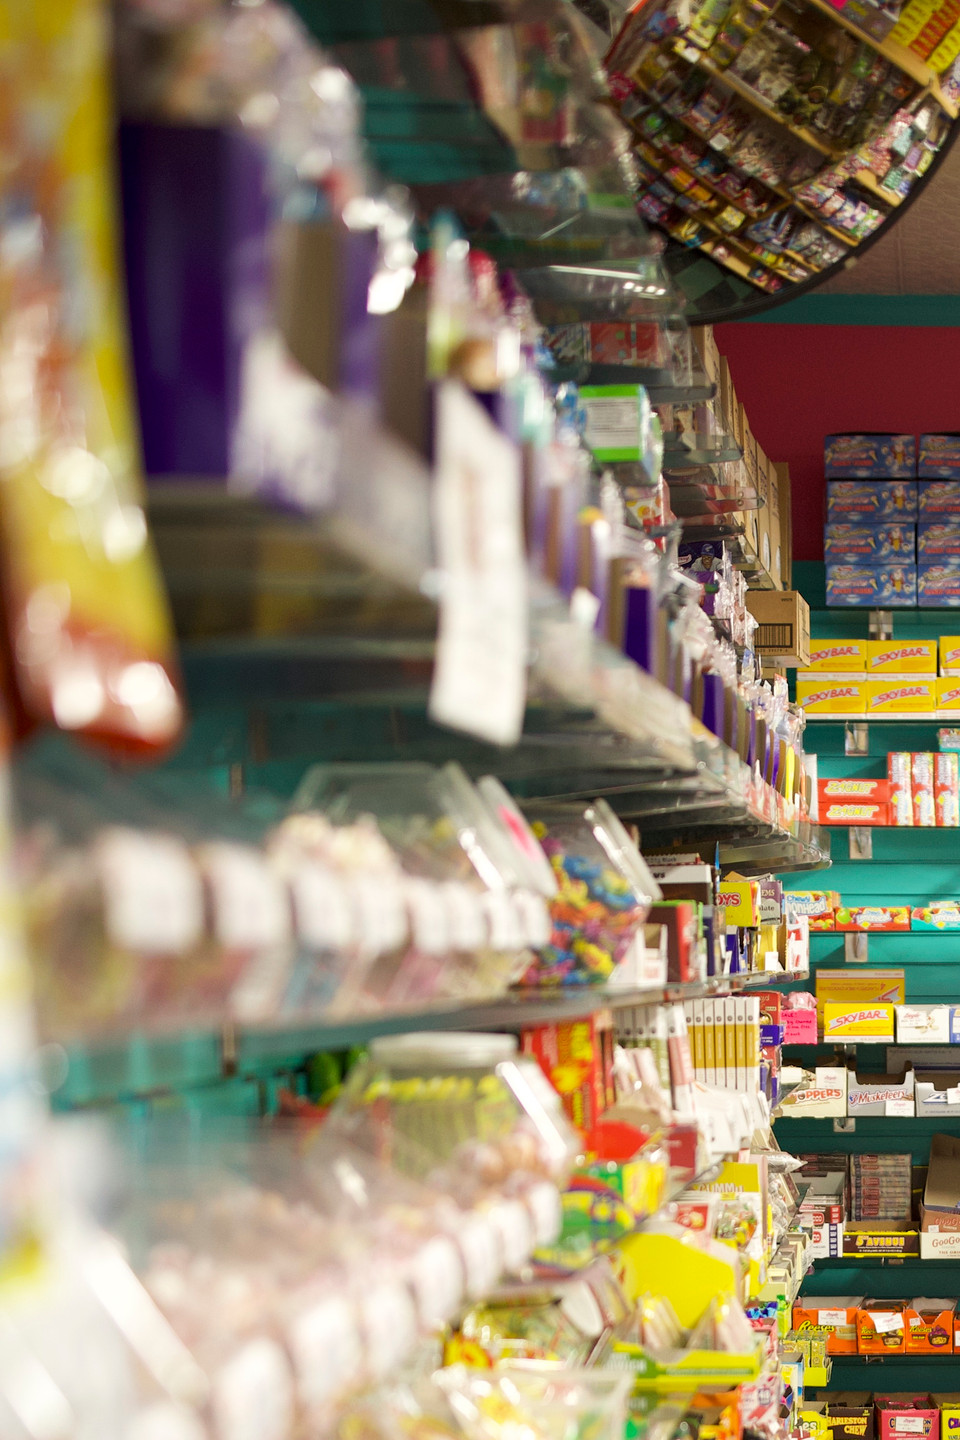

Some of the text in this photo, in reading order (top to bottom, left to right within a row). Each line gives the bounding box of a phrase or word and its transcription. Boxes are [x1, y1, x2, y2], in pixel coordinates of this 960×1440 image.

[900, 647, 925, 657] BAR
[808, 687, 854, 703] SKY BAR
[878, 687, 925, 703] SKY BAR
[826, 782, 876, 793] ZAGNUT
[827, 806, 877, 818] ZAGNUT
[786, 895, 811, 904] Chewy
[835, 1015, 861, 1028] SKY
[866, 1236, 905, 1247] AVENUE
[844, 1425, 868, 1436] CHEW
